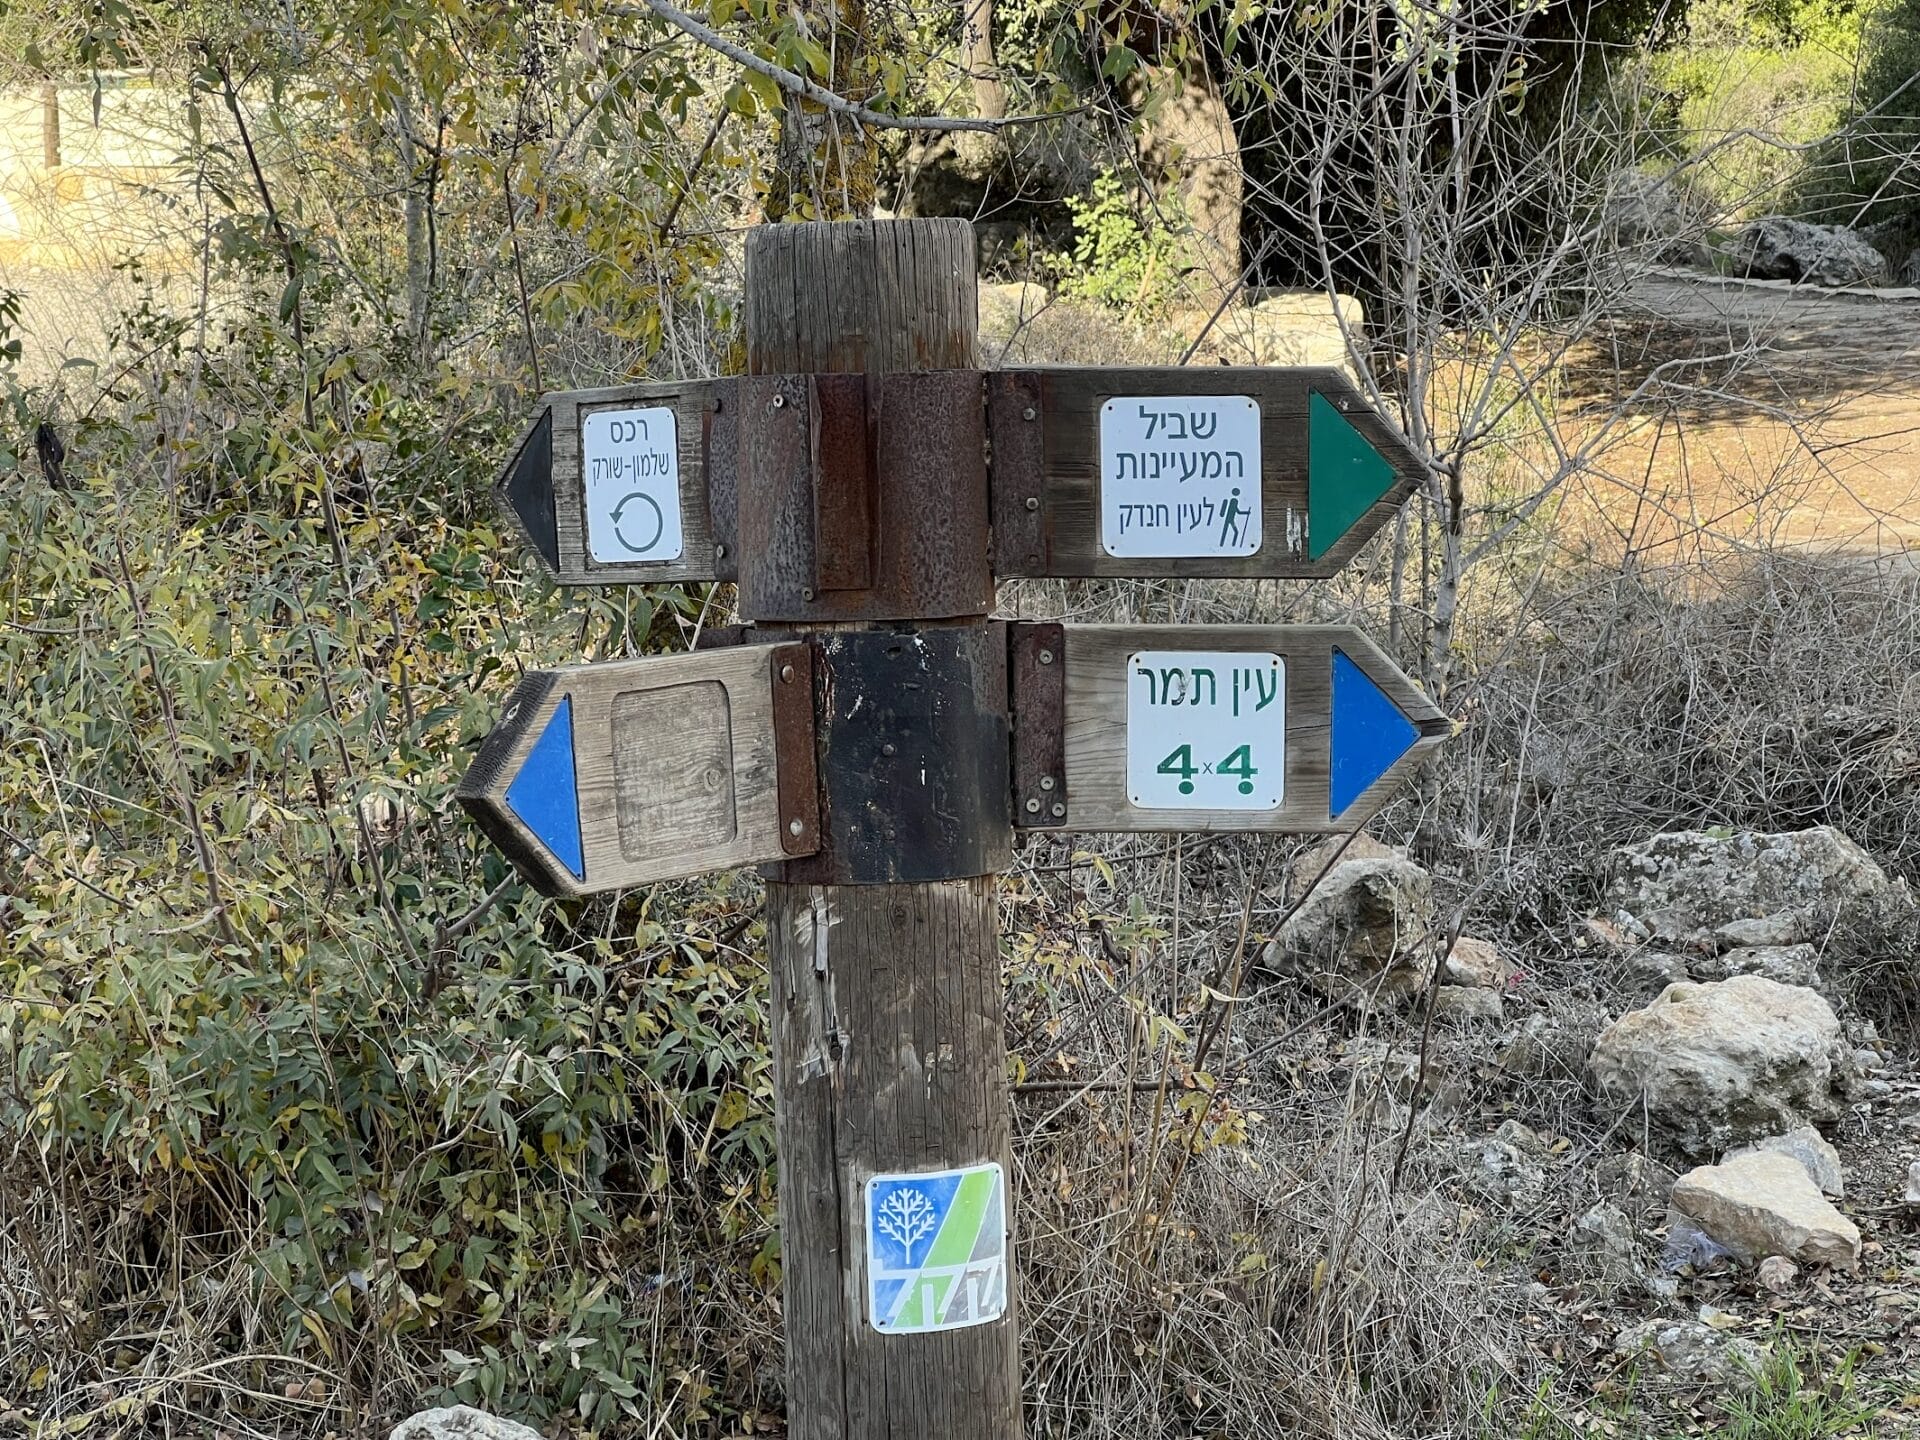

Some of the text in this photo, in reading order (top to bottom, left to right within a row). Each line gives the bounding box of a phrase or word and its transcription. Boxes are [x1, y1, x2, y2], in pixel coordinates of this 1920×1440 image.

[610, 419, 649, 444] רכס
[1138, 405, 1217, 440] שביל
[592, 448, 669, 487] שלמון-שורק
[1115, 451, 1244, 483] המעיינות
[1119, 496, 1215, 535] לעין חנדק
[1137, 667, 1277, 717] עין תמר
